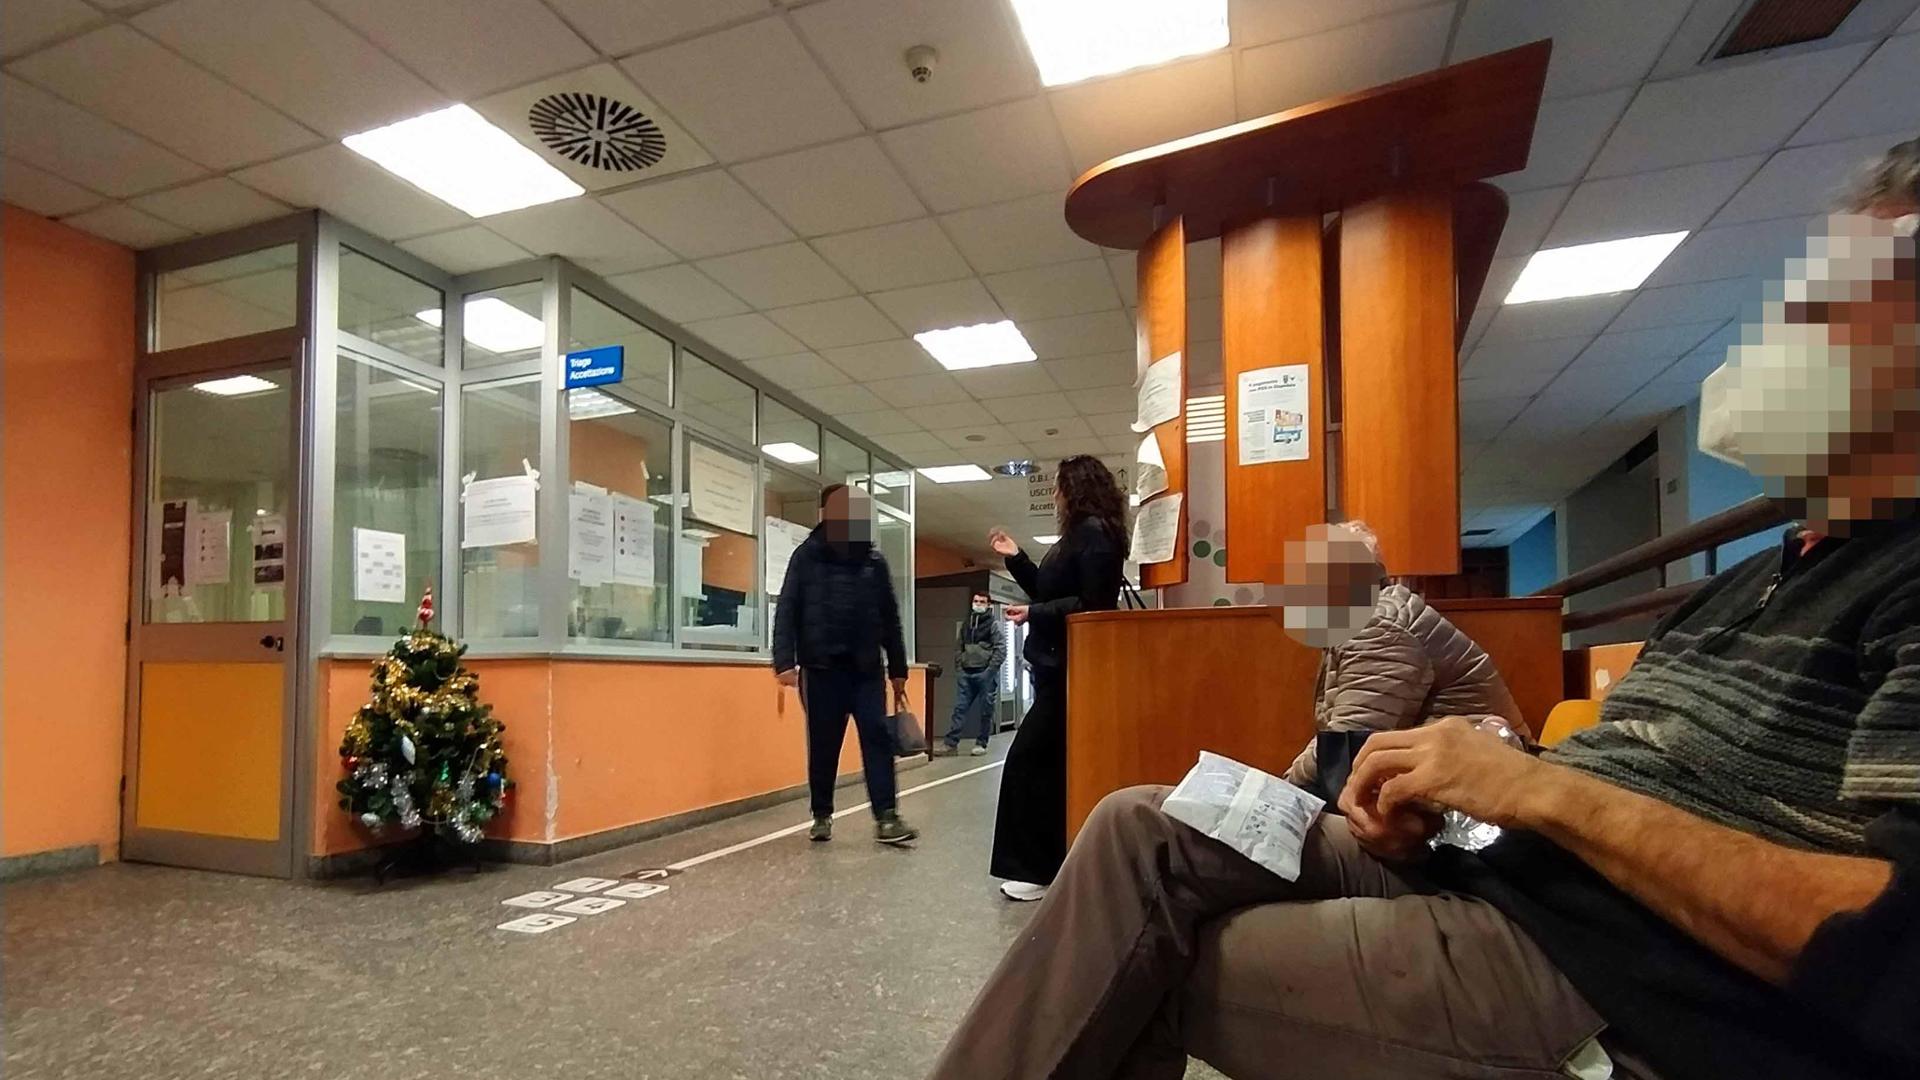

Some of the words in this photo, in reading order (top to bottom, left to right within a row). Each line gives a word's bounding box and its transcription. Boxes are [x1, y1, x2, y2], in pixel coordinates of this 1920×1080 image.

[570, 357, 592, 369] Triage
[570, 367, 615, 379] Accettazione
[1030, 503, 1056, 511] Accett
